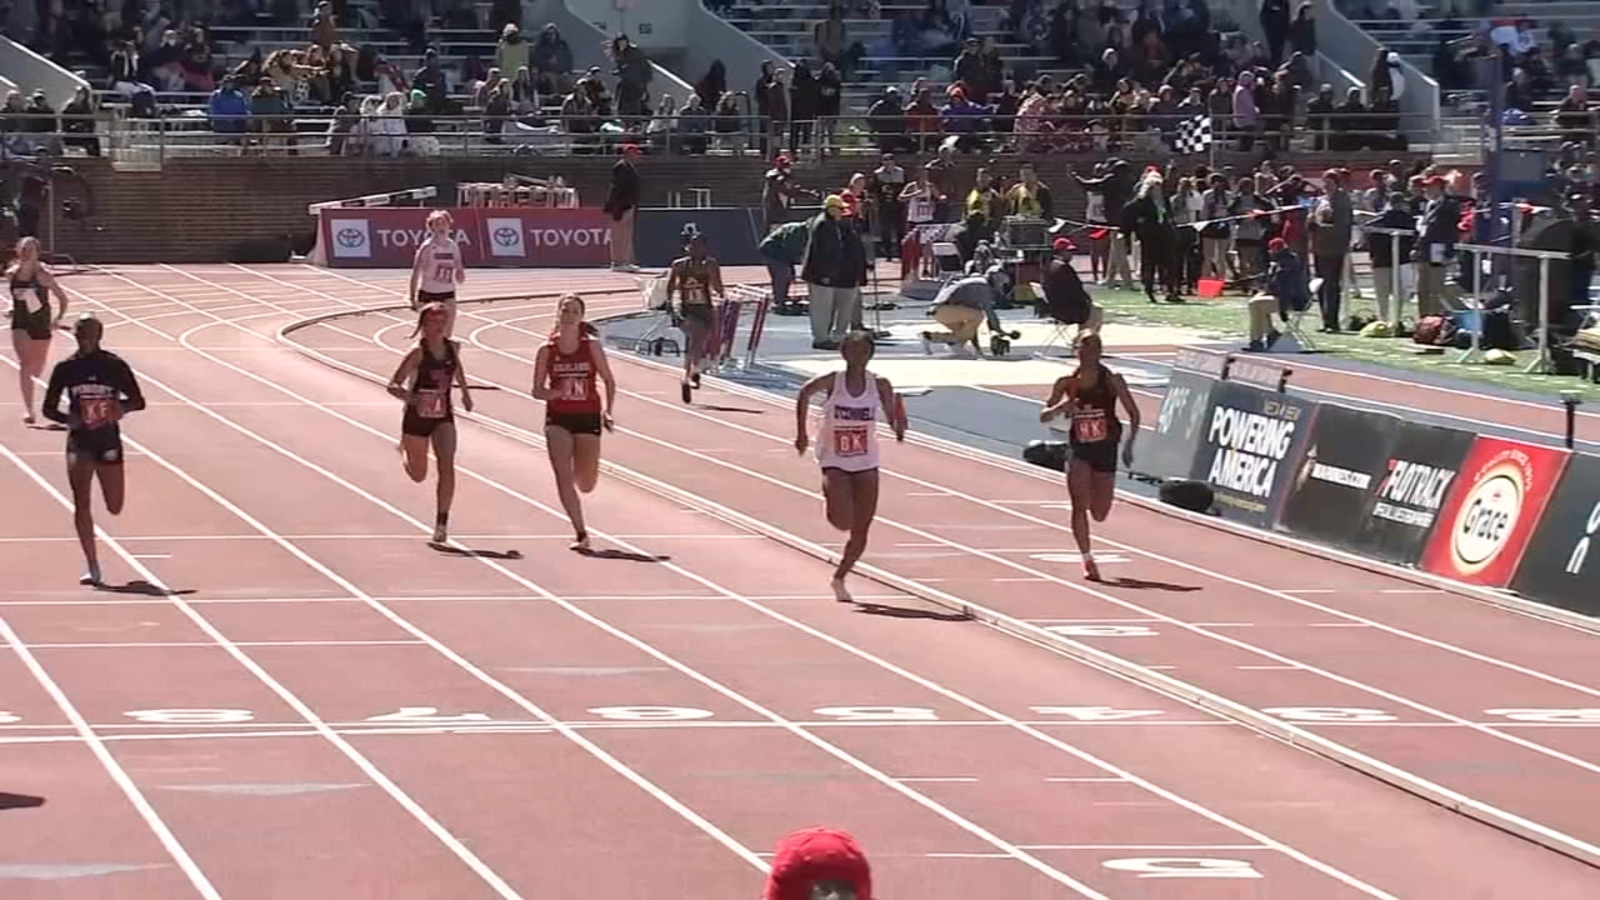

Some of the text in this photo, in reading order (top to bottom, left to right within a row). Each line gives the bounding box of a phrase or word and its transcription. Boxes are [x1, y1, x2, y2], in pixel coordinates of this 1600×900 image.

[376, 229, 471, 247] TOYOA
[1208, 405, 1296, 460] POWERING
[1207, 448, 1278, 498] AMERICA
[1462, 497, 1509, 541] Grace
